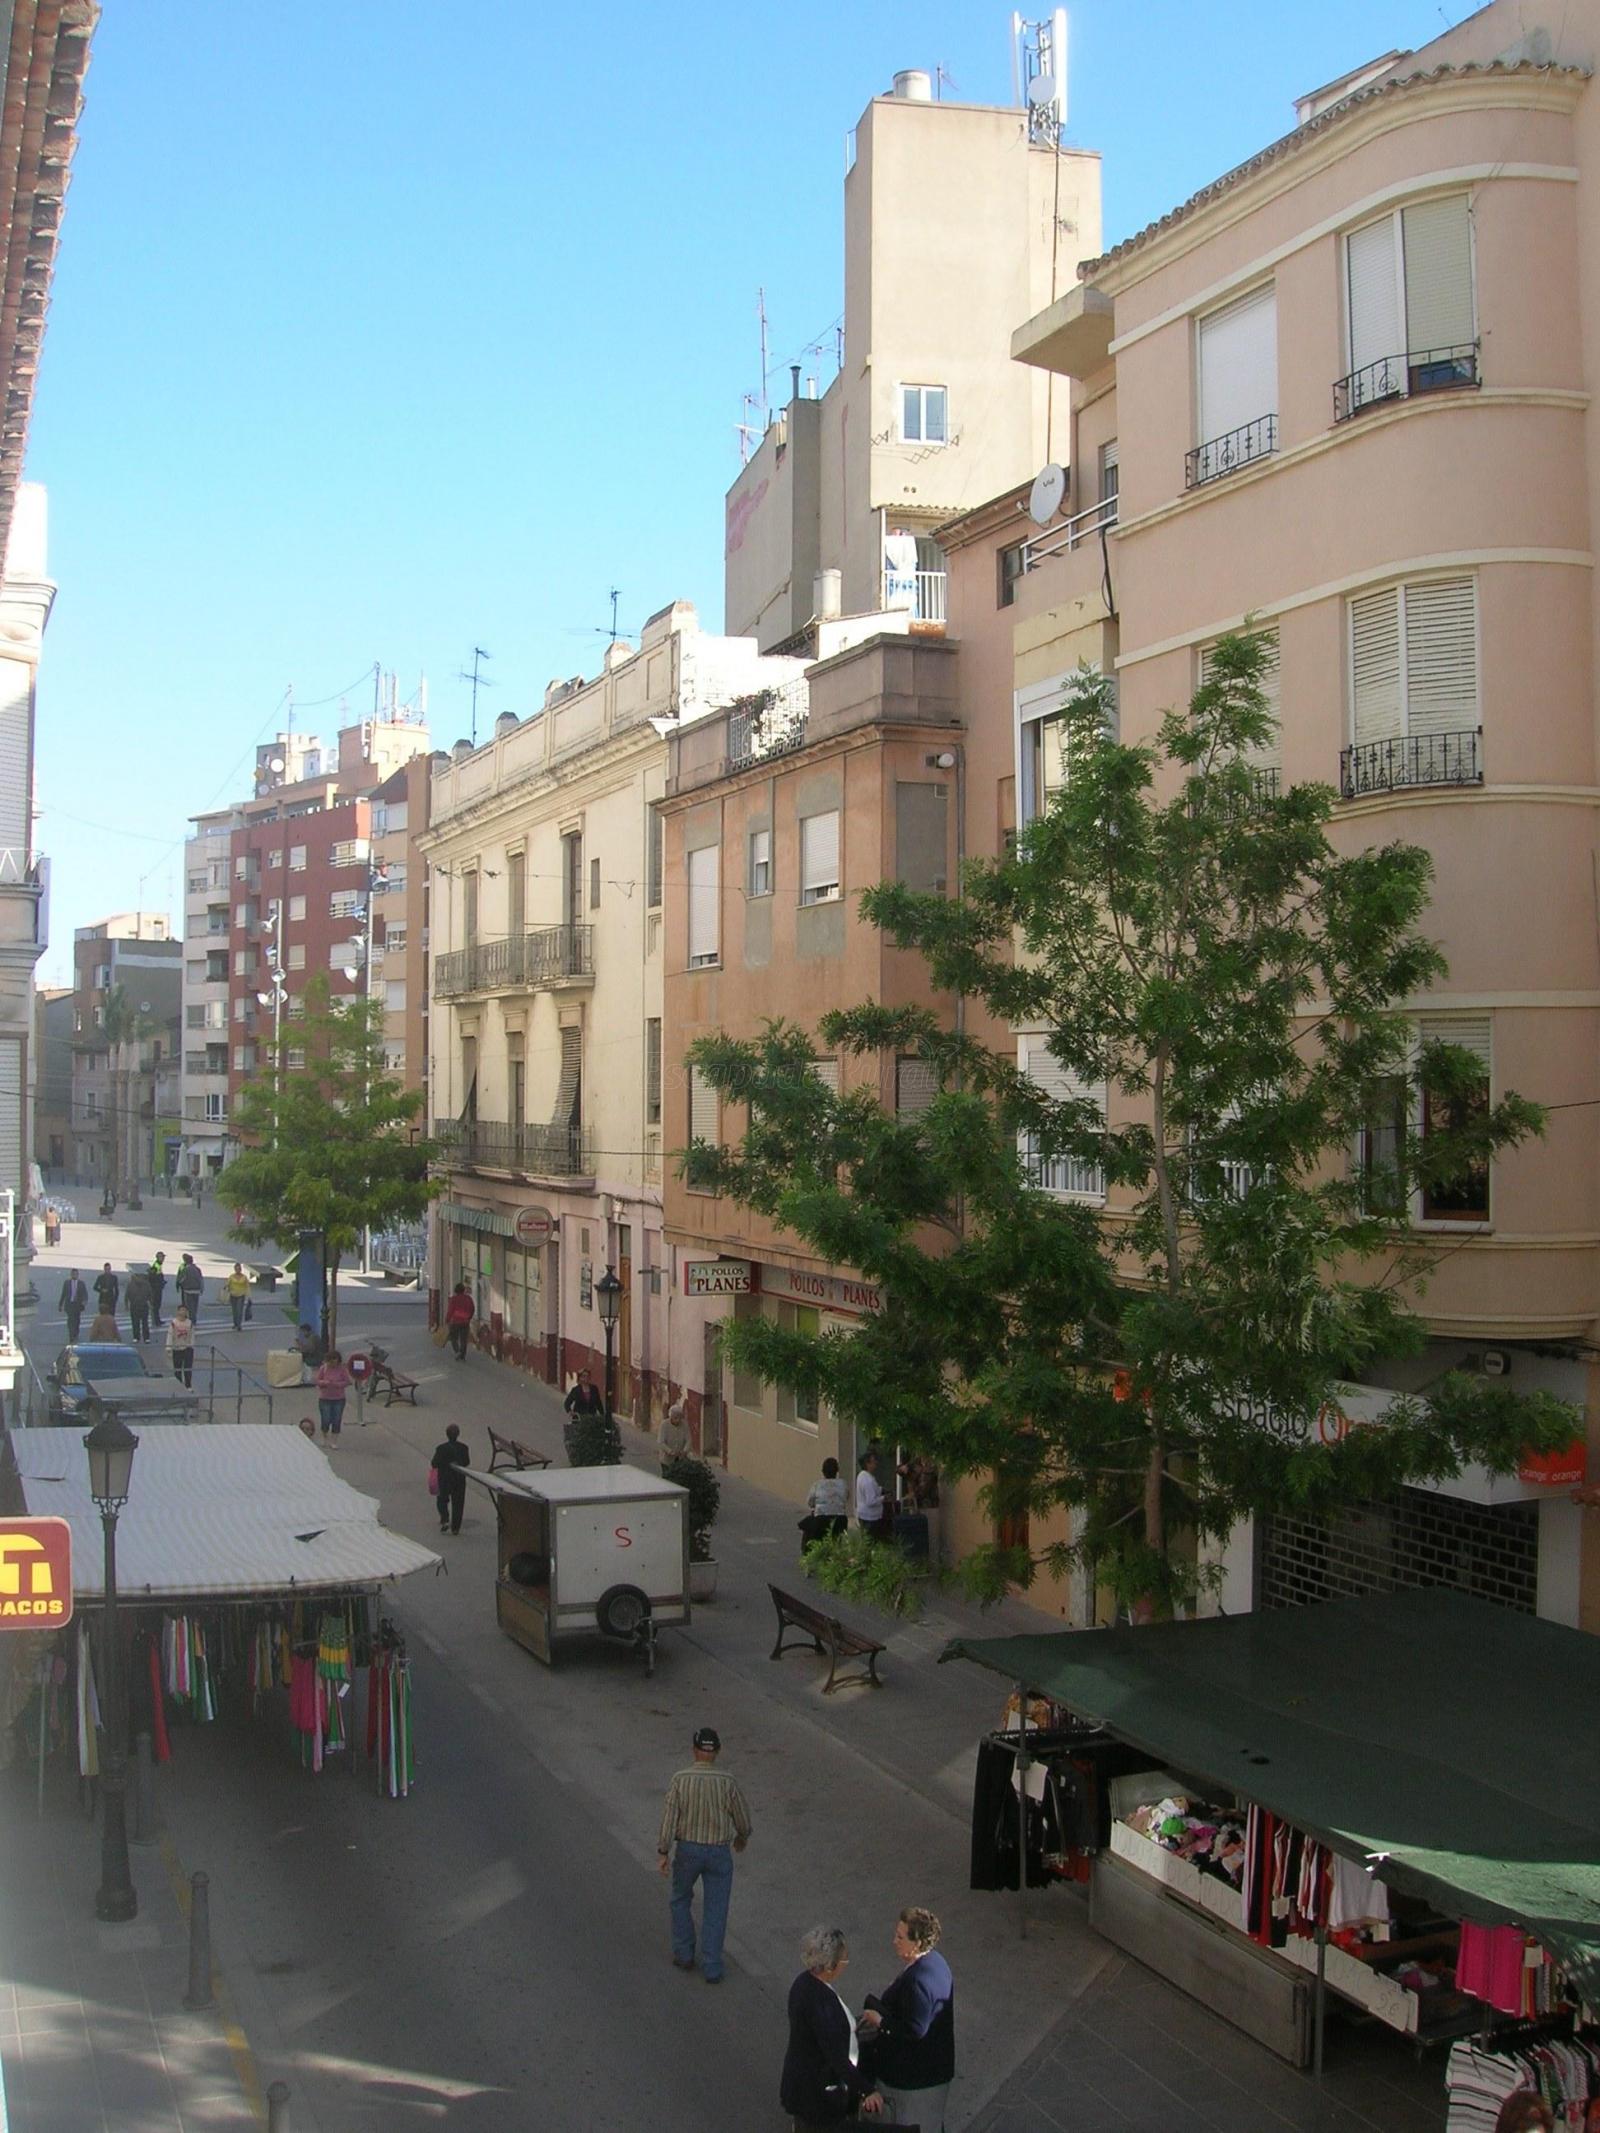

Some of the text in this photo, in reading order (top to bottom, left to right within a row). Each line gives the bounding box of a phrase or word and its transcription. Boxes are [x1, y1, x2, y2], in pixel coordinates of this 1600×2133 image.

[711, 1267, 744, 1276] POLLOS
[697, 1277, 750, 1291] PLANES
[789, 1273, 880, 1309] POLLOS PLANES
[614, 1527, 632, 1548] S
[0, 1600, 64, 1616] ACOS
